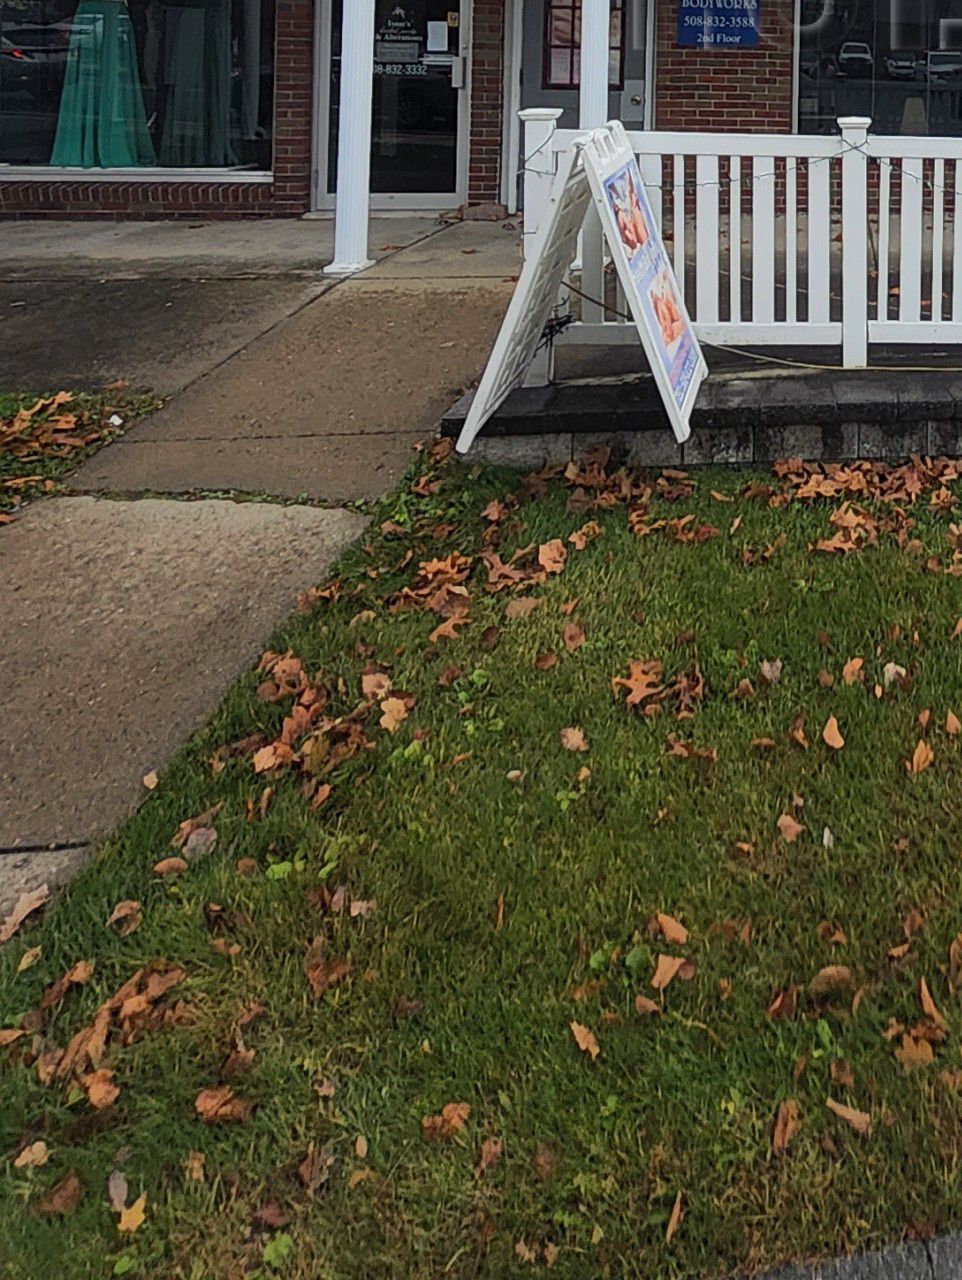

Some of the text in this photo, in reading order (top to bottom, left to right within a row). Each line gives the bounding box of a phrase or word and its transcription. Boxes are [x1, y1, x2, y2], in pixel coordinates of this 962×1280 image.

[683, 15, 755, 28] 508-832-3588
[696, 33, 741, 44] 2nd Floor
